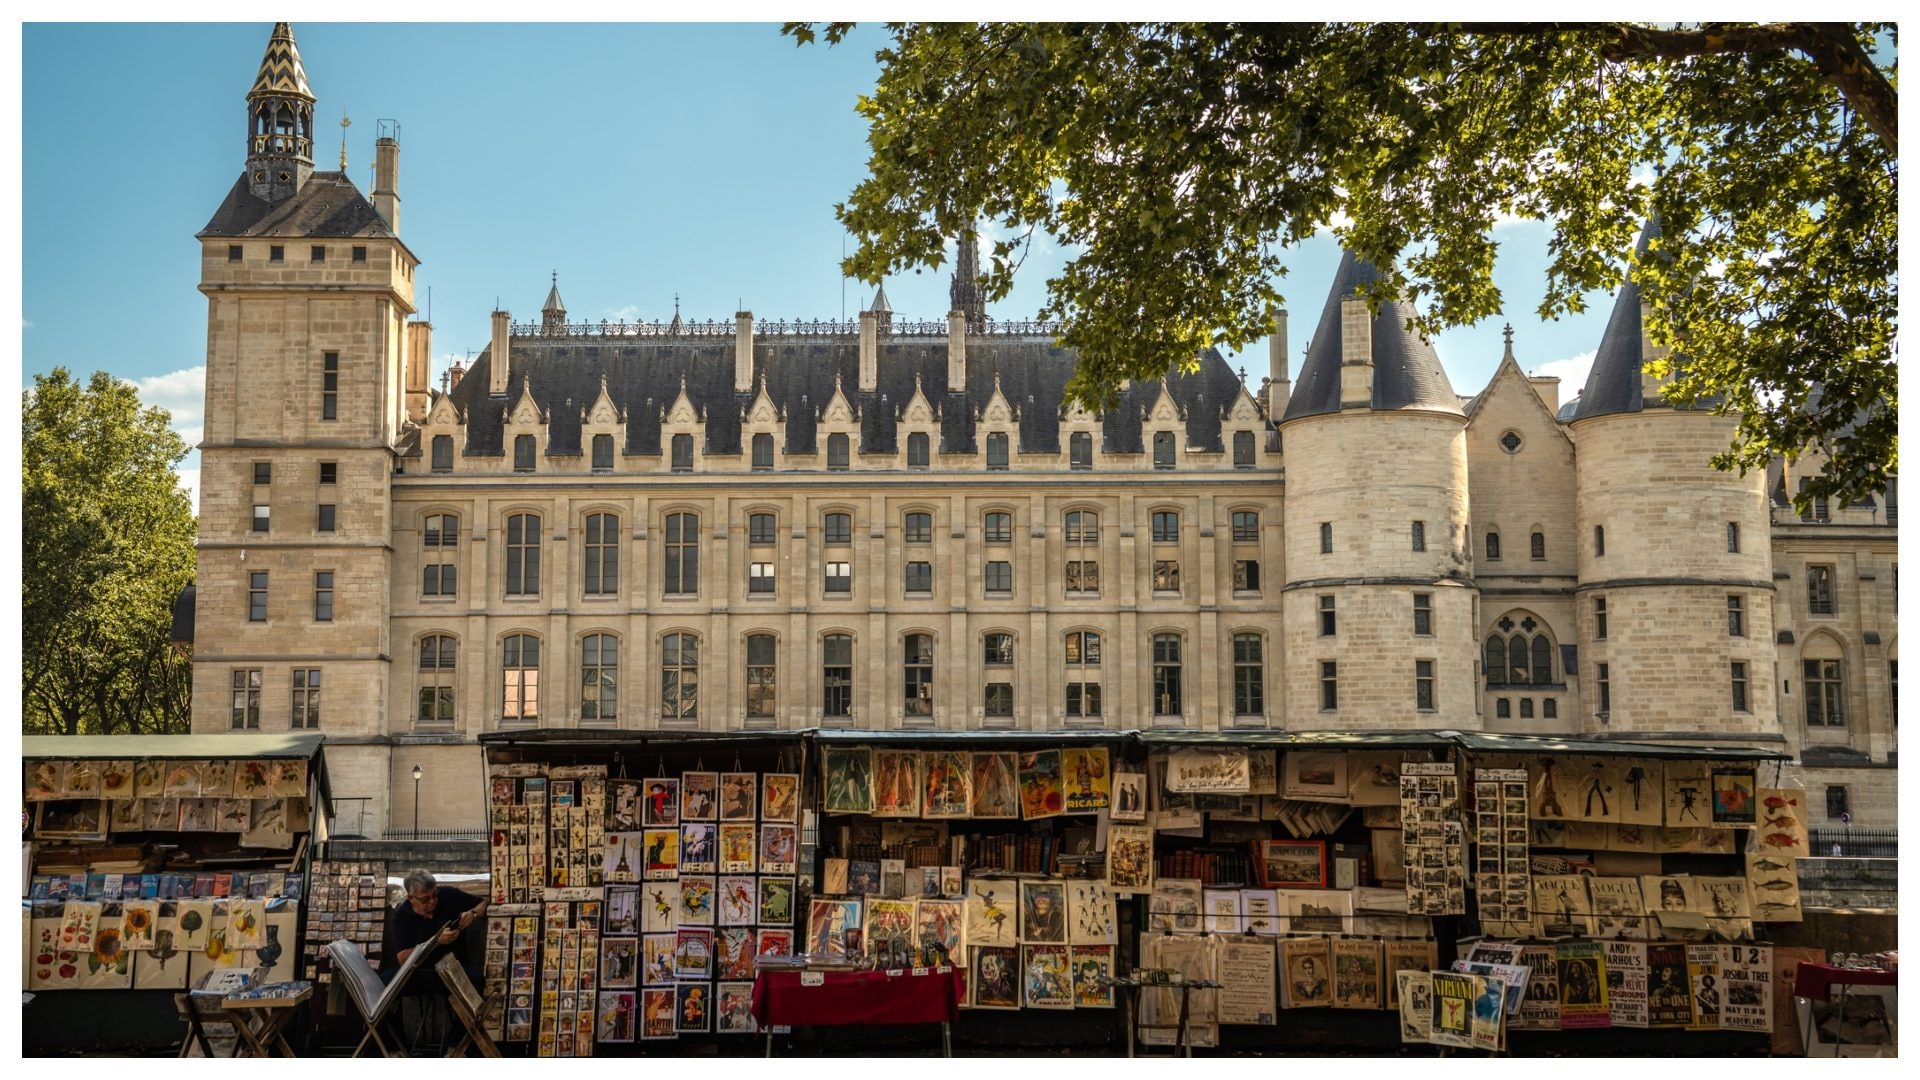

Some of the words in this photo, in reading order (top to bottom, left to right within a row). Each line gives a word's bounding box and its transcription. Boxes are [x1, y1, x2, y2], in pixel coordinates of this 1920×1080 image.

[1066, 799, 1109, 809] RICARD
[1593, 880, 1637, 895] VOGUE
[1701, 883, 1745, 894] VOUE
[1610, 943, 1631, 954] ANDY
[1732, 946, 1742, 963] U
[1749, 948, 1759, 964] 2
[1722, 968, 1749, 981] JOSHUA
[1752, 971, 1770, 982] TREE
[1434, 978, 1473, 1000] NIRVANA
[1625, 980, 1646, 991] VELVET
[1608, 990, 1646, 999] ERGROUND
[1649, 995, 1662, 1007] NE
[1671, 994, 1690, 1007] ONE
[1725, 1006, 1742, 1014] MAY
[1725, 1016, 1767, 1026] MEADOWLANDS
